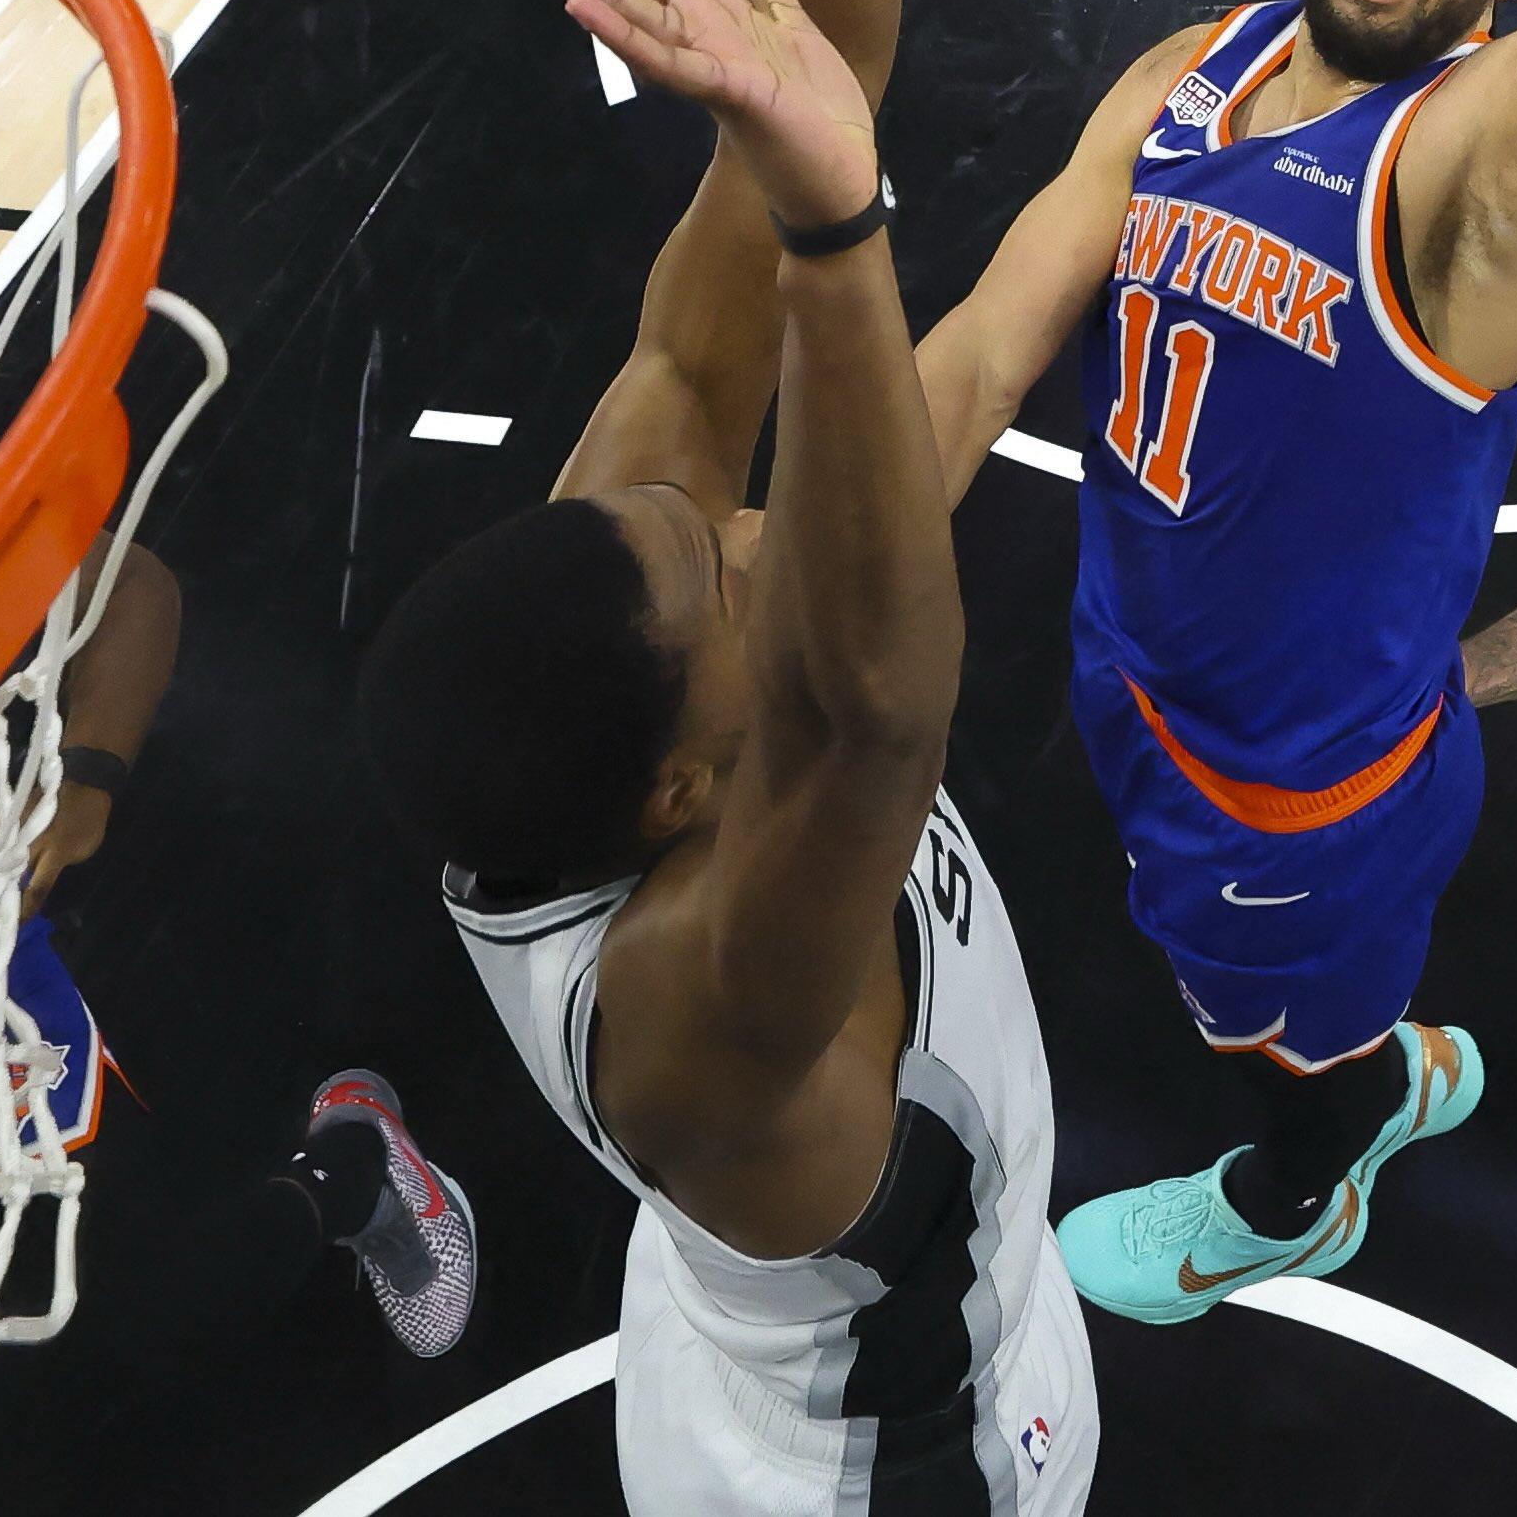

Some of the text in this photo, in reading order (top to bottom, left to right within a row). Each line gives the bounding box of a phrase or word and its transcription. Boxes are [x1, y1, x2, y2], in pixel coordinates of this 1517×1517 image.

[1170, 92, 1208, 123] 250
[1185, 77, 1217, 107] USA
[1273, 156, 1356, 196] abu dhabi
[1114, 193, 1354, 368] EW YORK
[1105, 283, 1215, 517] 11
